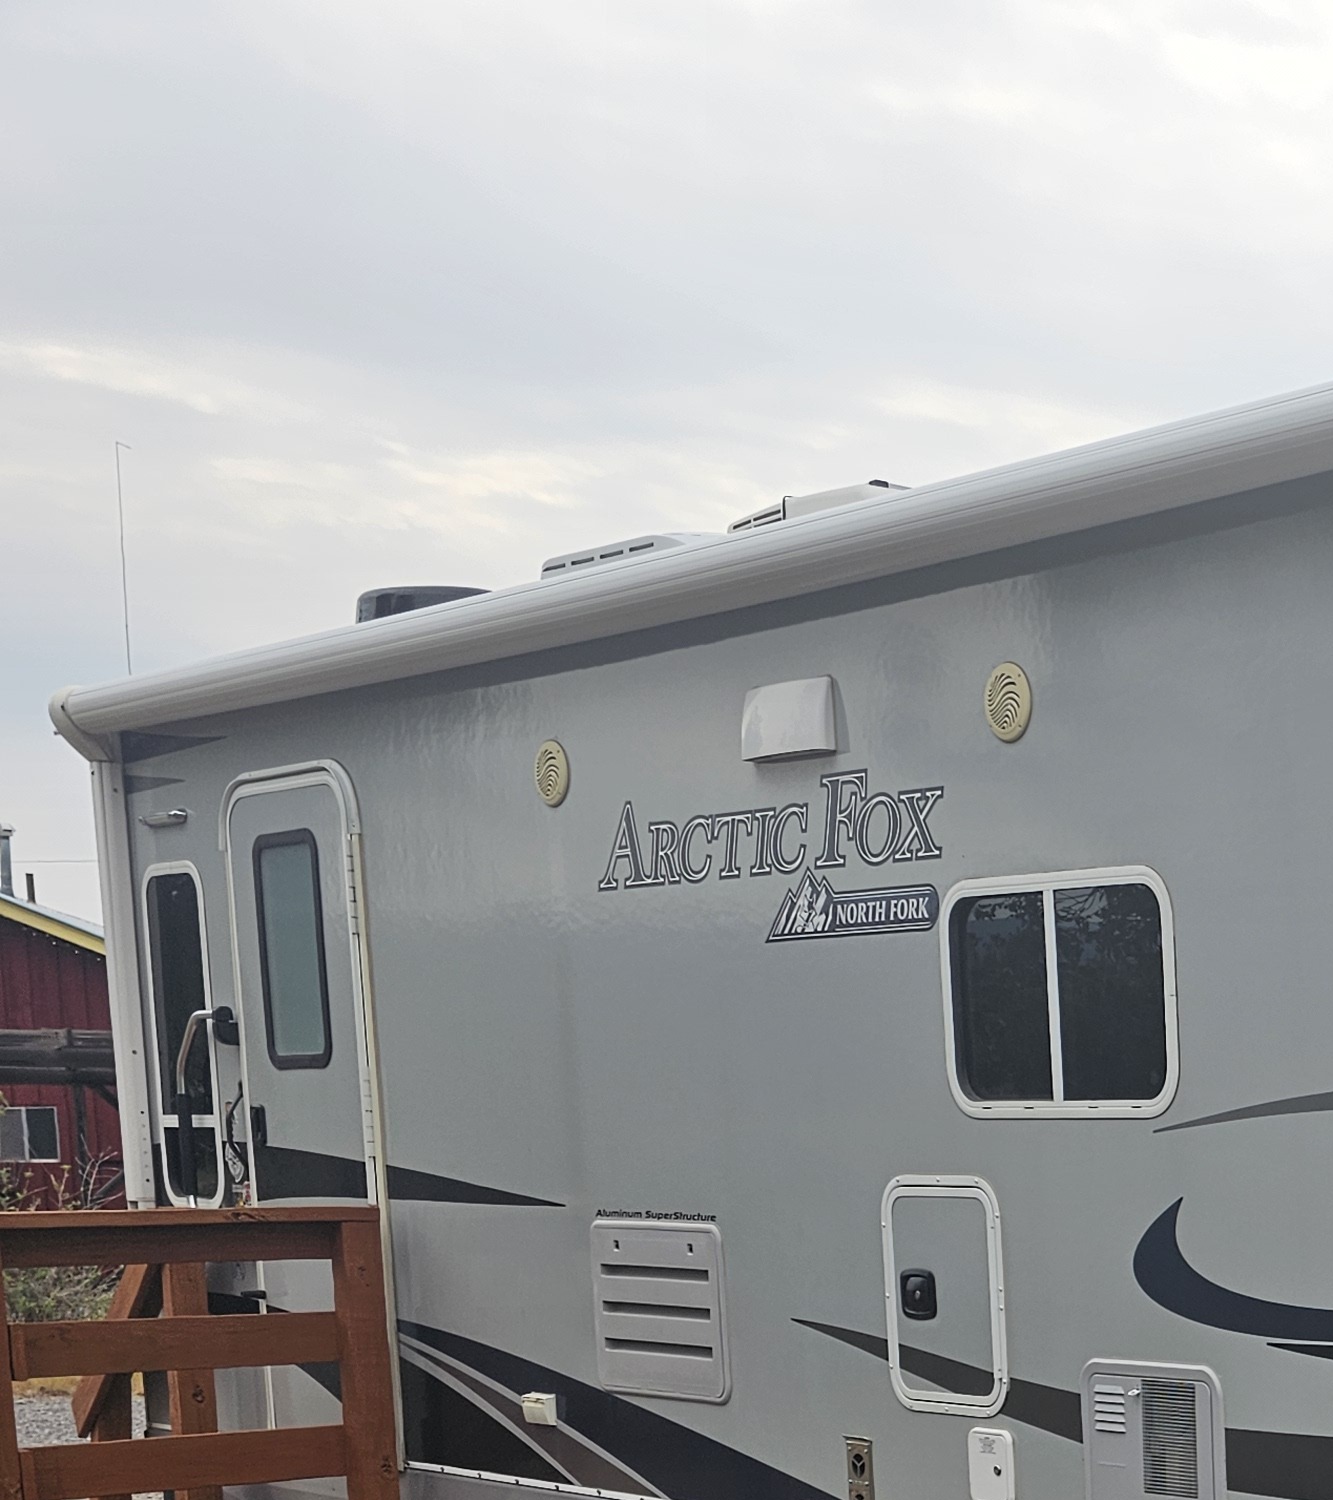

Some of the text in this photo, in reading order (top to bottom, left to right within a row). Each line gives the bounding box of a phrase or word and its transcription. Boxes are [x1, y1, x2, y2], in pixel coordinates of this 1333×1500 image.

[836, 897, 929, 926] NORTH FORK
[595, 1209, 717, 1222] Aluminum SuperStructure
